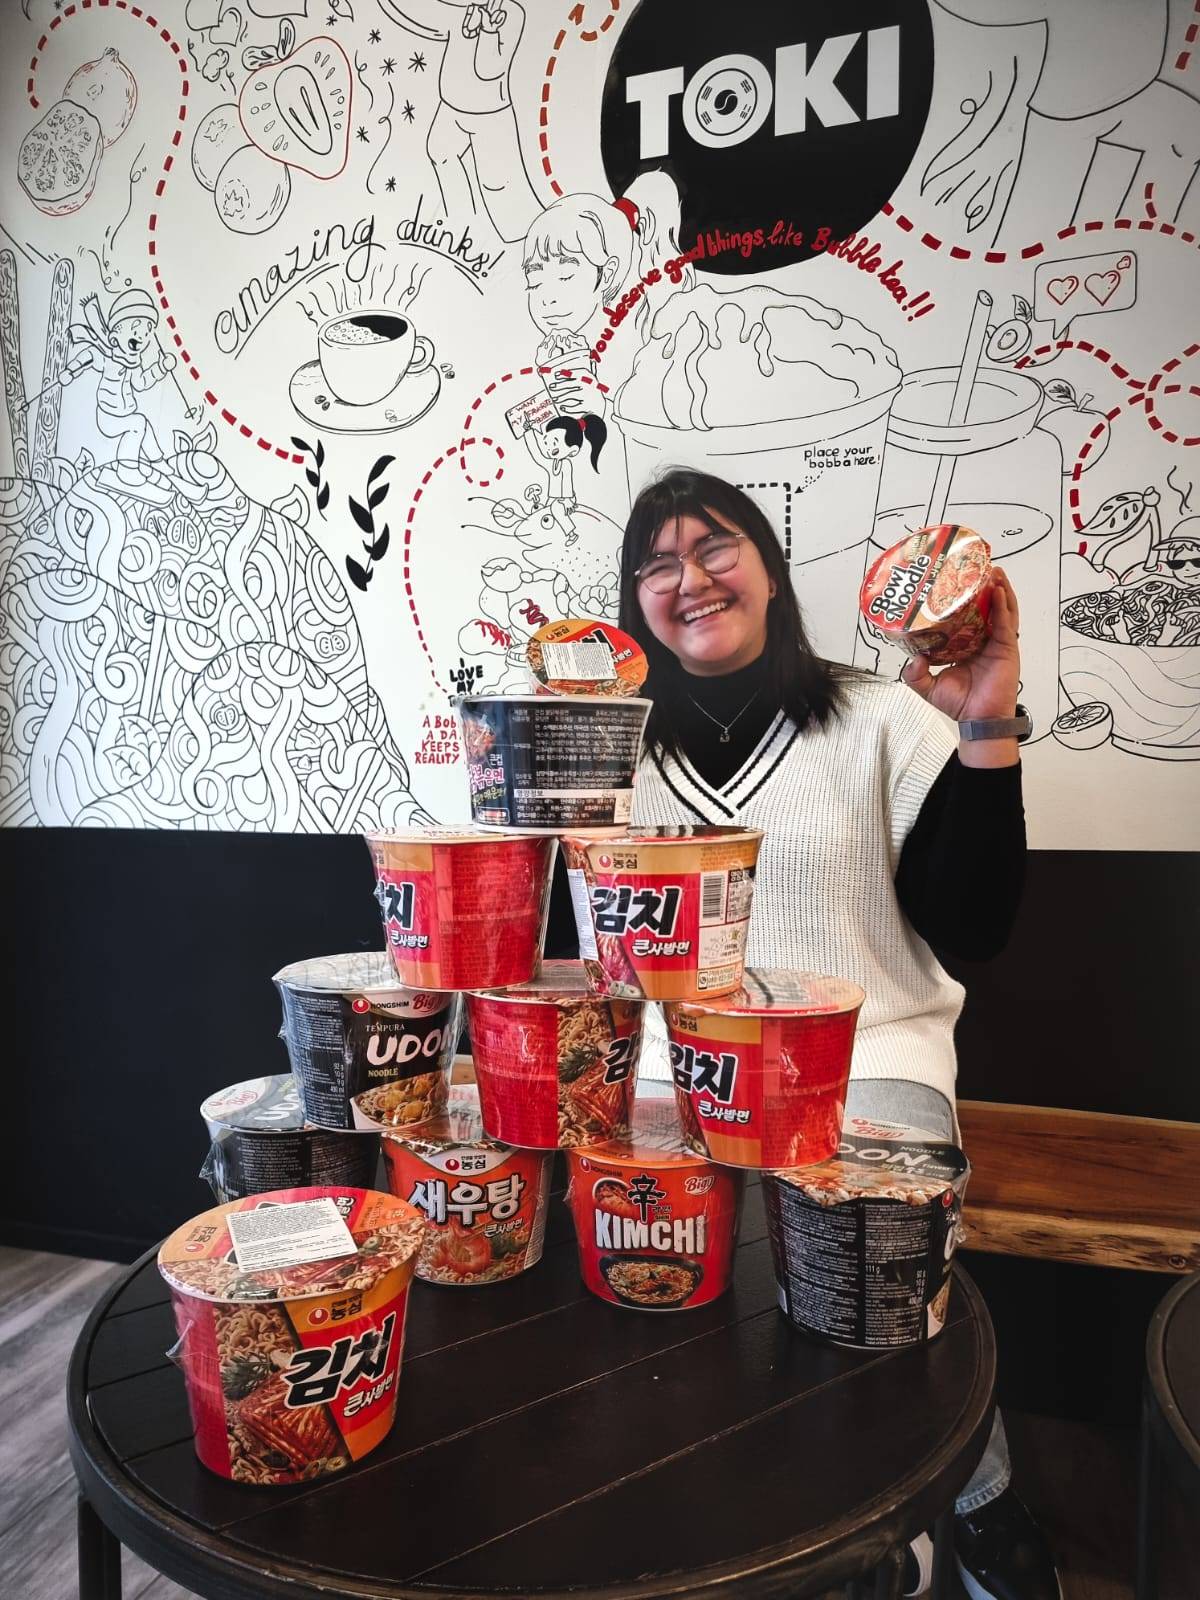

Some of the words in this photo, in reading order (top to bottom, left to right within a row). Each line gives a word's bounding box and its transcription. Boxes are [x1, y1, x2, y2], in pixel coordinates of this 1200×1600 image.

[626, 25, 900, 160] TOKI
[215, 215, 386, 353] amazing
[397, 194, 506, 278] drinks!
[590, 327, 614, 362] you
[602, 268, 662, 327] deserve
[664, 233, 705, 284] good
[767, 220, 803, 245] like
[811, 227, 882, 273] Bubble
[804, 445, 840, 461] place
[844, 446, 873, 458] your
[809, 456, 851, 468] bobba
[871, 565, 907, 614] Bowl
[886, 556, 930, 621] Noodle
[460, 657, 465, 668] I
[450, 665, 483, 682] LOVE
[457, 679, 474, 693] MY
[423, 715, 430, 728] A
[435, 714, 457, 729] Bob
[426, 730, 434, 740] A
[440, 729, 457, 740] DA
[421, 740, 460, 752] KEEPS
[415, 752, 460, 764] REALITY
[612, 858, 638, 869] 농심
[379, 881, 415, 931] 치
[591, 886, 682, 937] 김치
[391, 929, 429, 949] 큰사발면
[631, 939, 691, 956] 큰사발면
[366, 1023, 405, 1032] TEMPURA
[679, 1020, 698, 1032] 농심
[604, 1032, 637, 1084] 김
[368, 1067, 399, 1078] NOODLE
[669, 1044, 737, 1103] 김치
[698, 1101, 752, 1123] 큰사발면
[900, 1146, 945, 1155] NOODLE
[461, 1160, 486, 1170] 농심
[408, 1174, 526, 1226] 새우탕
[627, 1173, 666, 1223] 辛
[484, 1218, 524, 1238] 큰사발면
[595, 1208, 705, 1254] KIMCHI
[331, 1300, 362, 1320] 농심
[284, 1311, 396, 1408] 김치
[344, 1370, 394, 1417] 큰사발면
